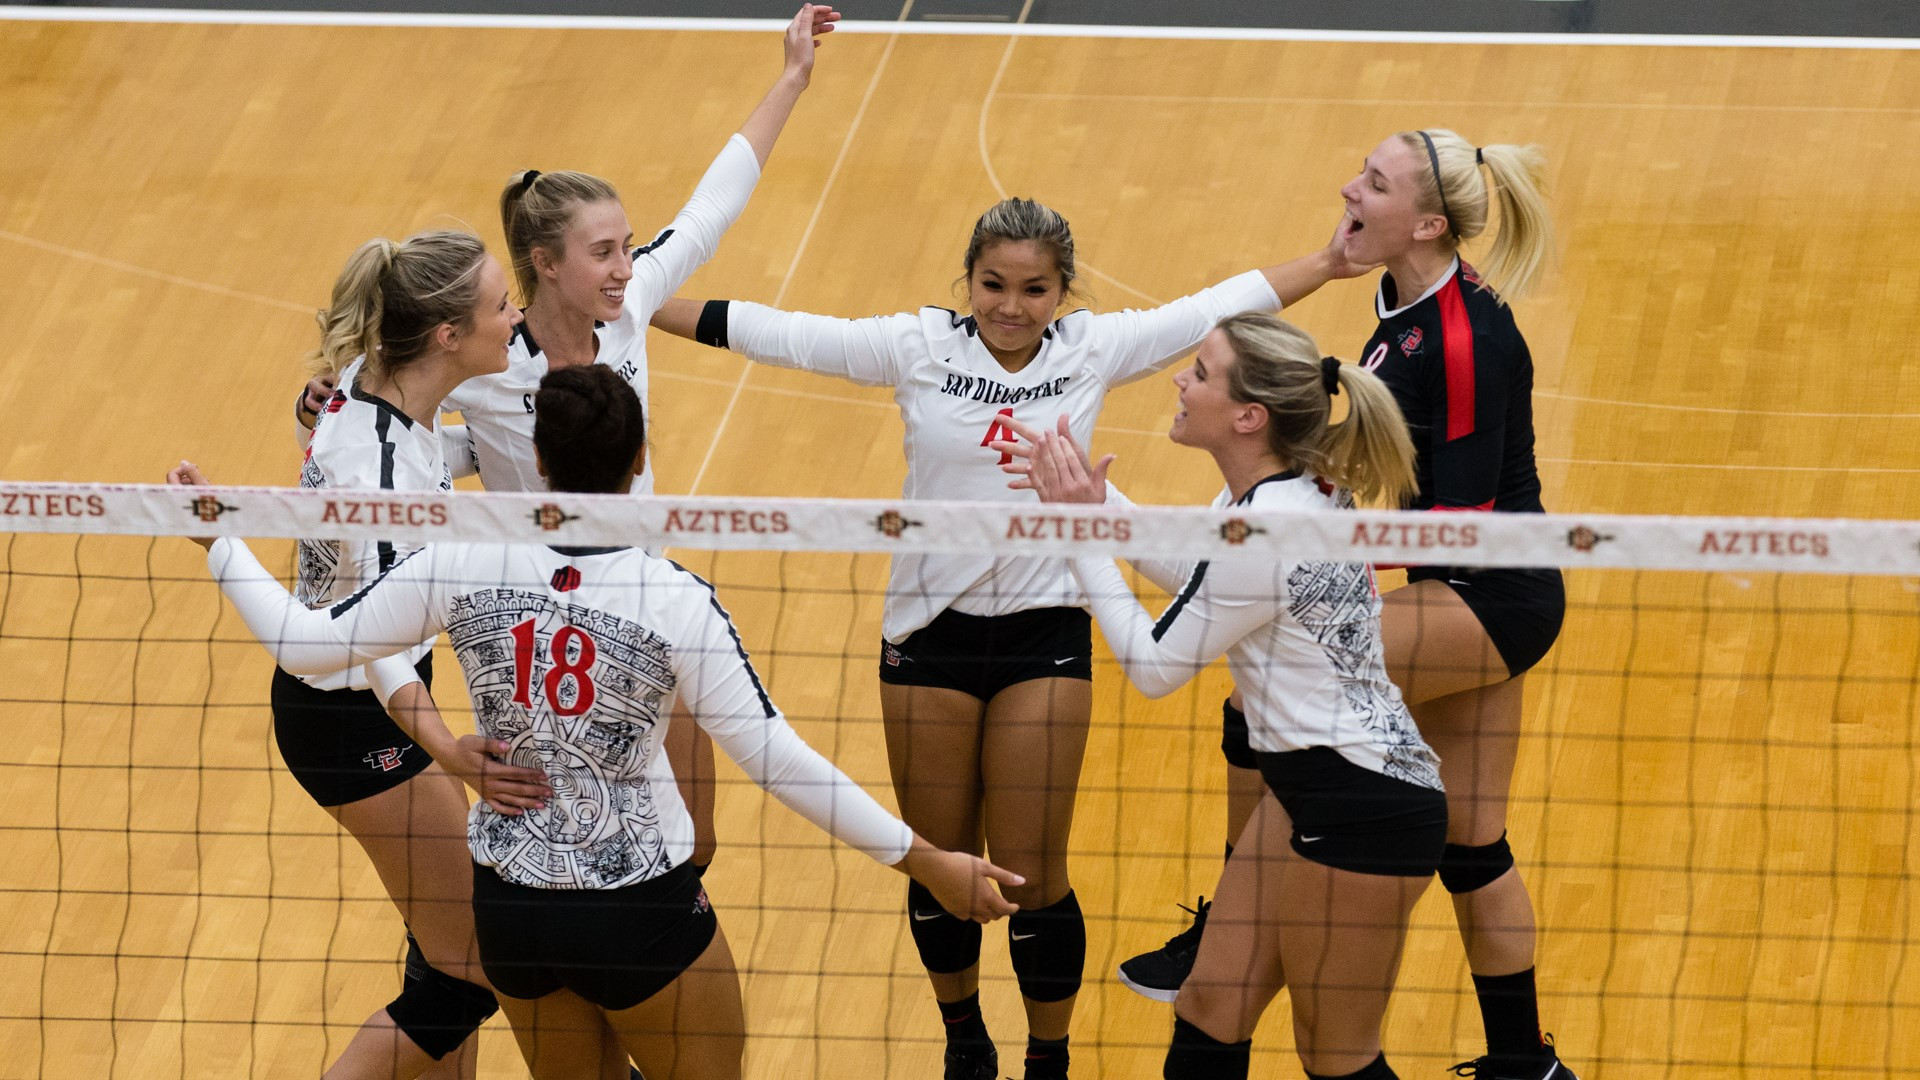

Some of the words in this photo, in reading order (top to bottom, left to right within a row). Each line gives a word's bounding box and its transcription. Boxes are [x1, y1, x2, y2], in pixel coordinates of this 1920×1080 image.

[940, 373, 973, 399] SAN
[979, 407, 1020, 466] 4
[0, 492, 106, 517] ZTECS
[320, 500, 448, 527] AZTECS
[663, 508, 790, 534] AZTECS
[1006, 514, 1132, 542] AZTECS
[1351, 521, 1478, 549] AZTECS
[1699, 530, 1830, 558] AZTECS
[509, 616, 598, 718] 18
